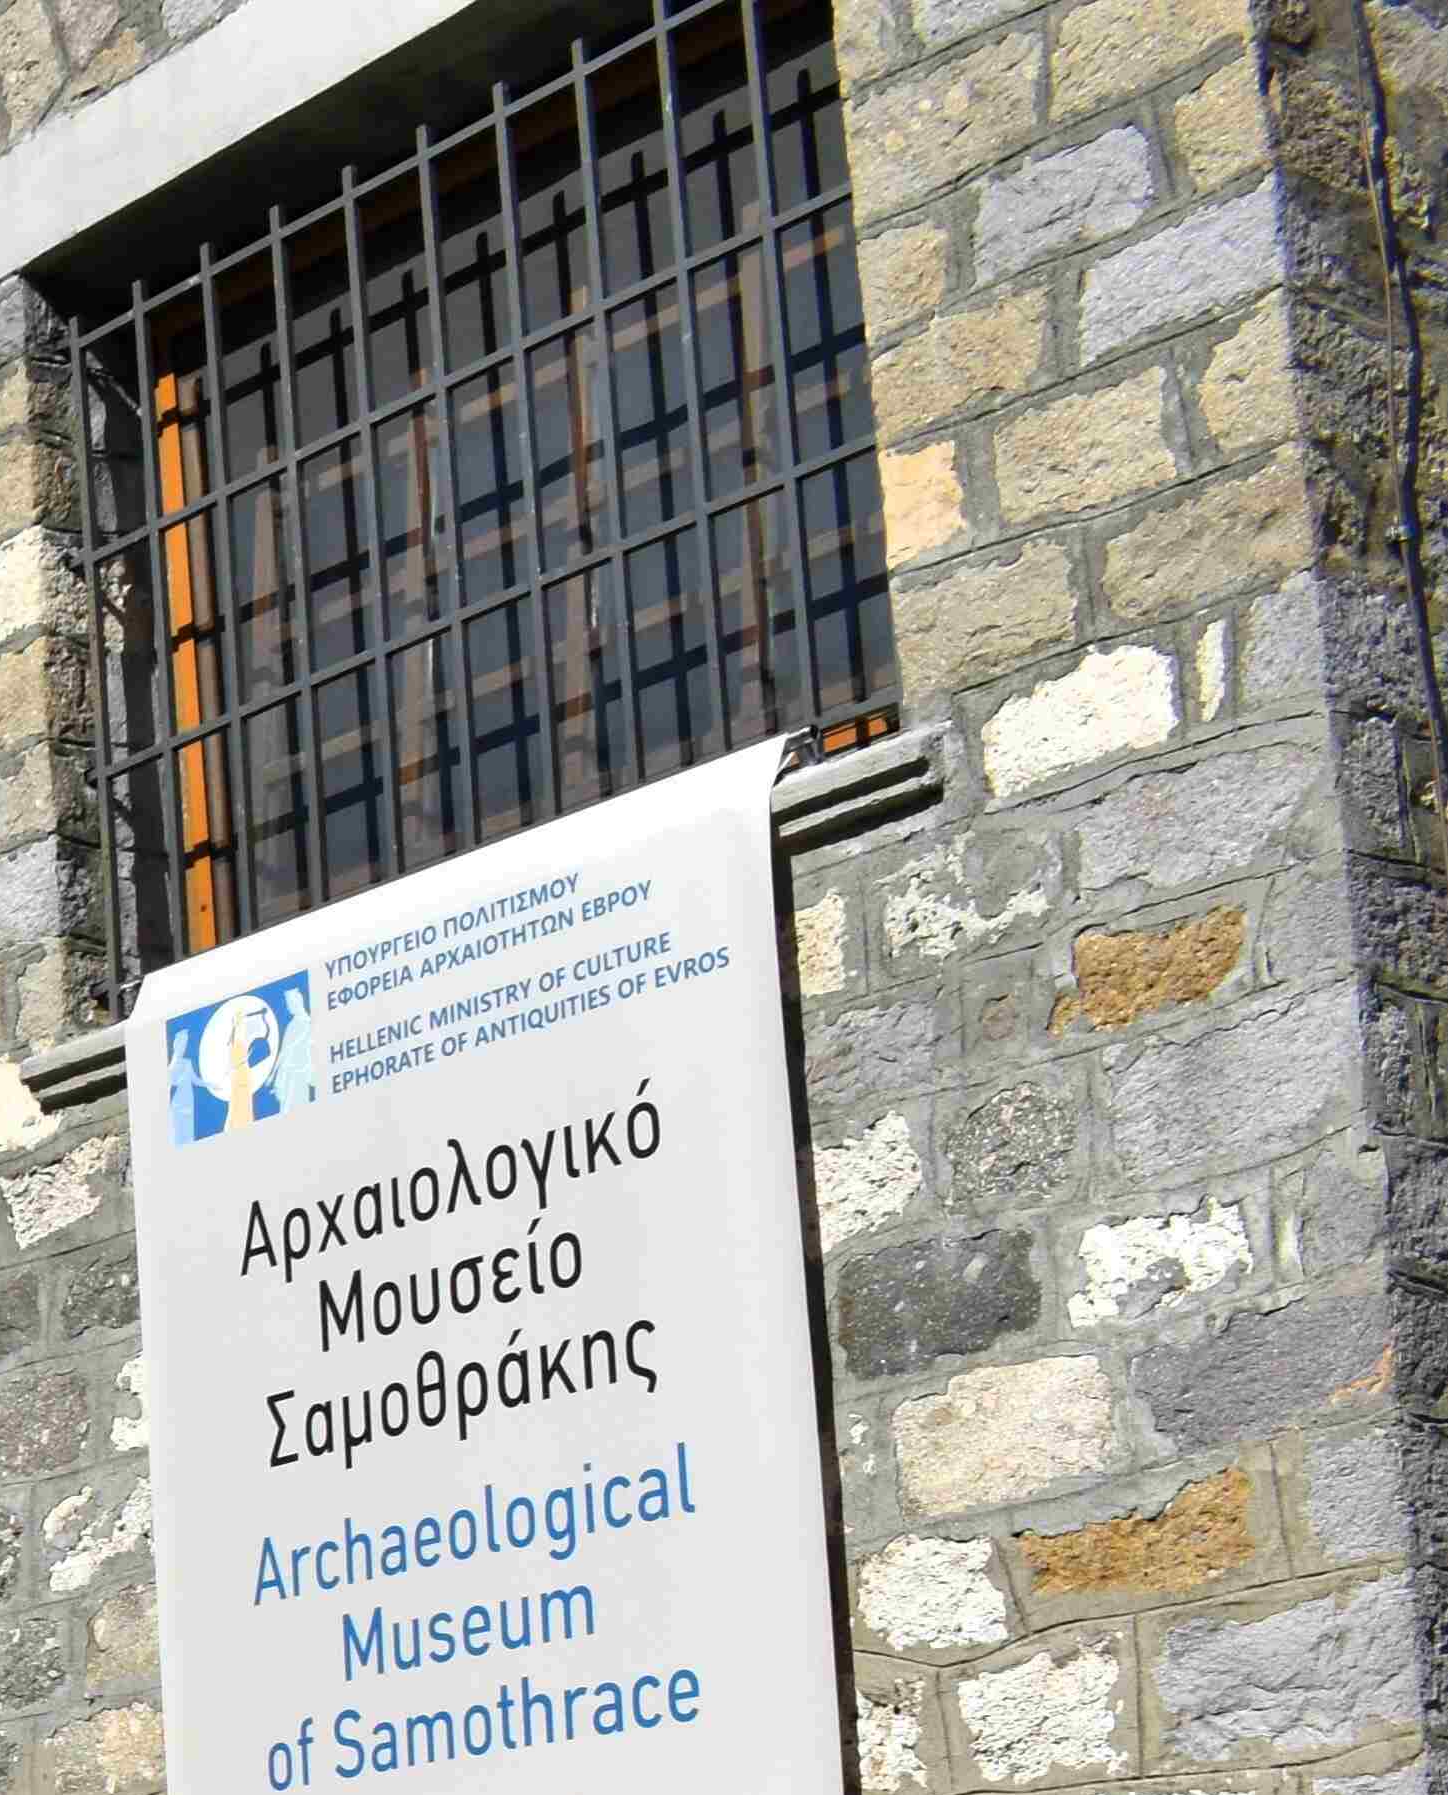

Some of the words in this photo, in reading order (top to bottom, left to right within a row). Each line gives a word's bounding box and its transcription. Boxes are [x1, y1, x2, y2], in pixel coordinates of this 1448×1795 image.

[325, 925, 437, 979] ΥΠΟΥΡΓΕΙΟ
[443, 872, 578, 938] ΠΟΛΙΤΙΣΜΟΥ
[327, 965, 413, 1010] ΕΦΟΡΕΙΑ
[420, 907, 574, 978] ΑΡΧΑΙΟΤΗΤΩΝ
[581, 880, 651, 922] ΕΒΡΟΥ
[330, 1015, 422, 1064] HELLENIC
[429, 978, 531, 1030] MINISTRY
[539, 967, 566, 993] OF
[573, 932, 671, 981] CULTURE
[332, 1043, 435, 1094] EPHORATE
[441, 1032, 467, 1056] OF
[475, 985, 610, 1047] ANTIQUITIES
[617, 973, 646, 999] OF
[655, 947, 729, 988] EVROS
[241, 1078, 661, 1281] Αρχαιολογικό
[319, 1219, 583, 1351] Μουσείο
[266, 1320, 658, 1469] Σαμοθράκης
[255, 1442, 696, 1605] Archaeological
[342, 1583, 595, 1681] Museum
[267, 1718, 313, 1792] of
[334, 1668, 701, 1779] Samothrace
